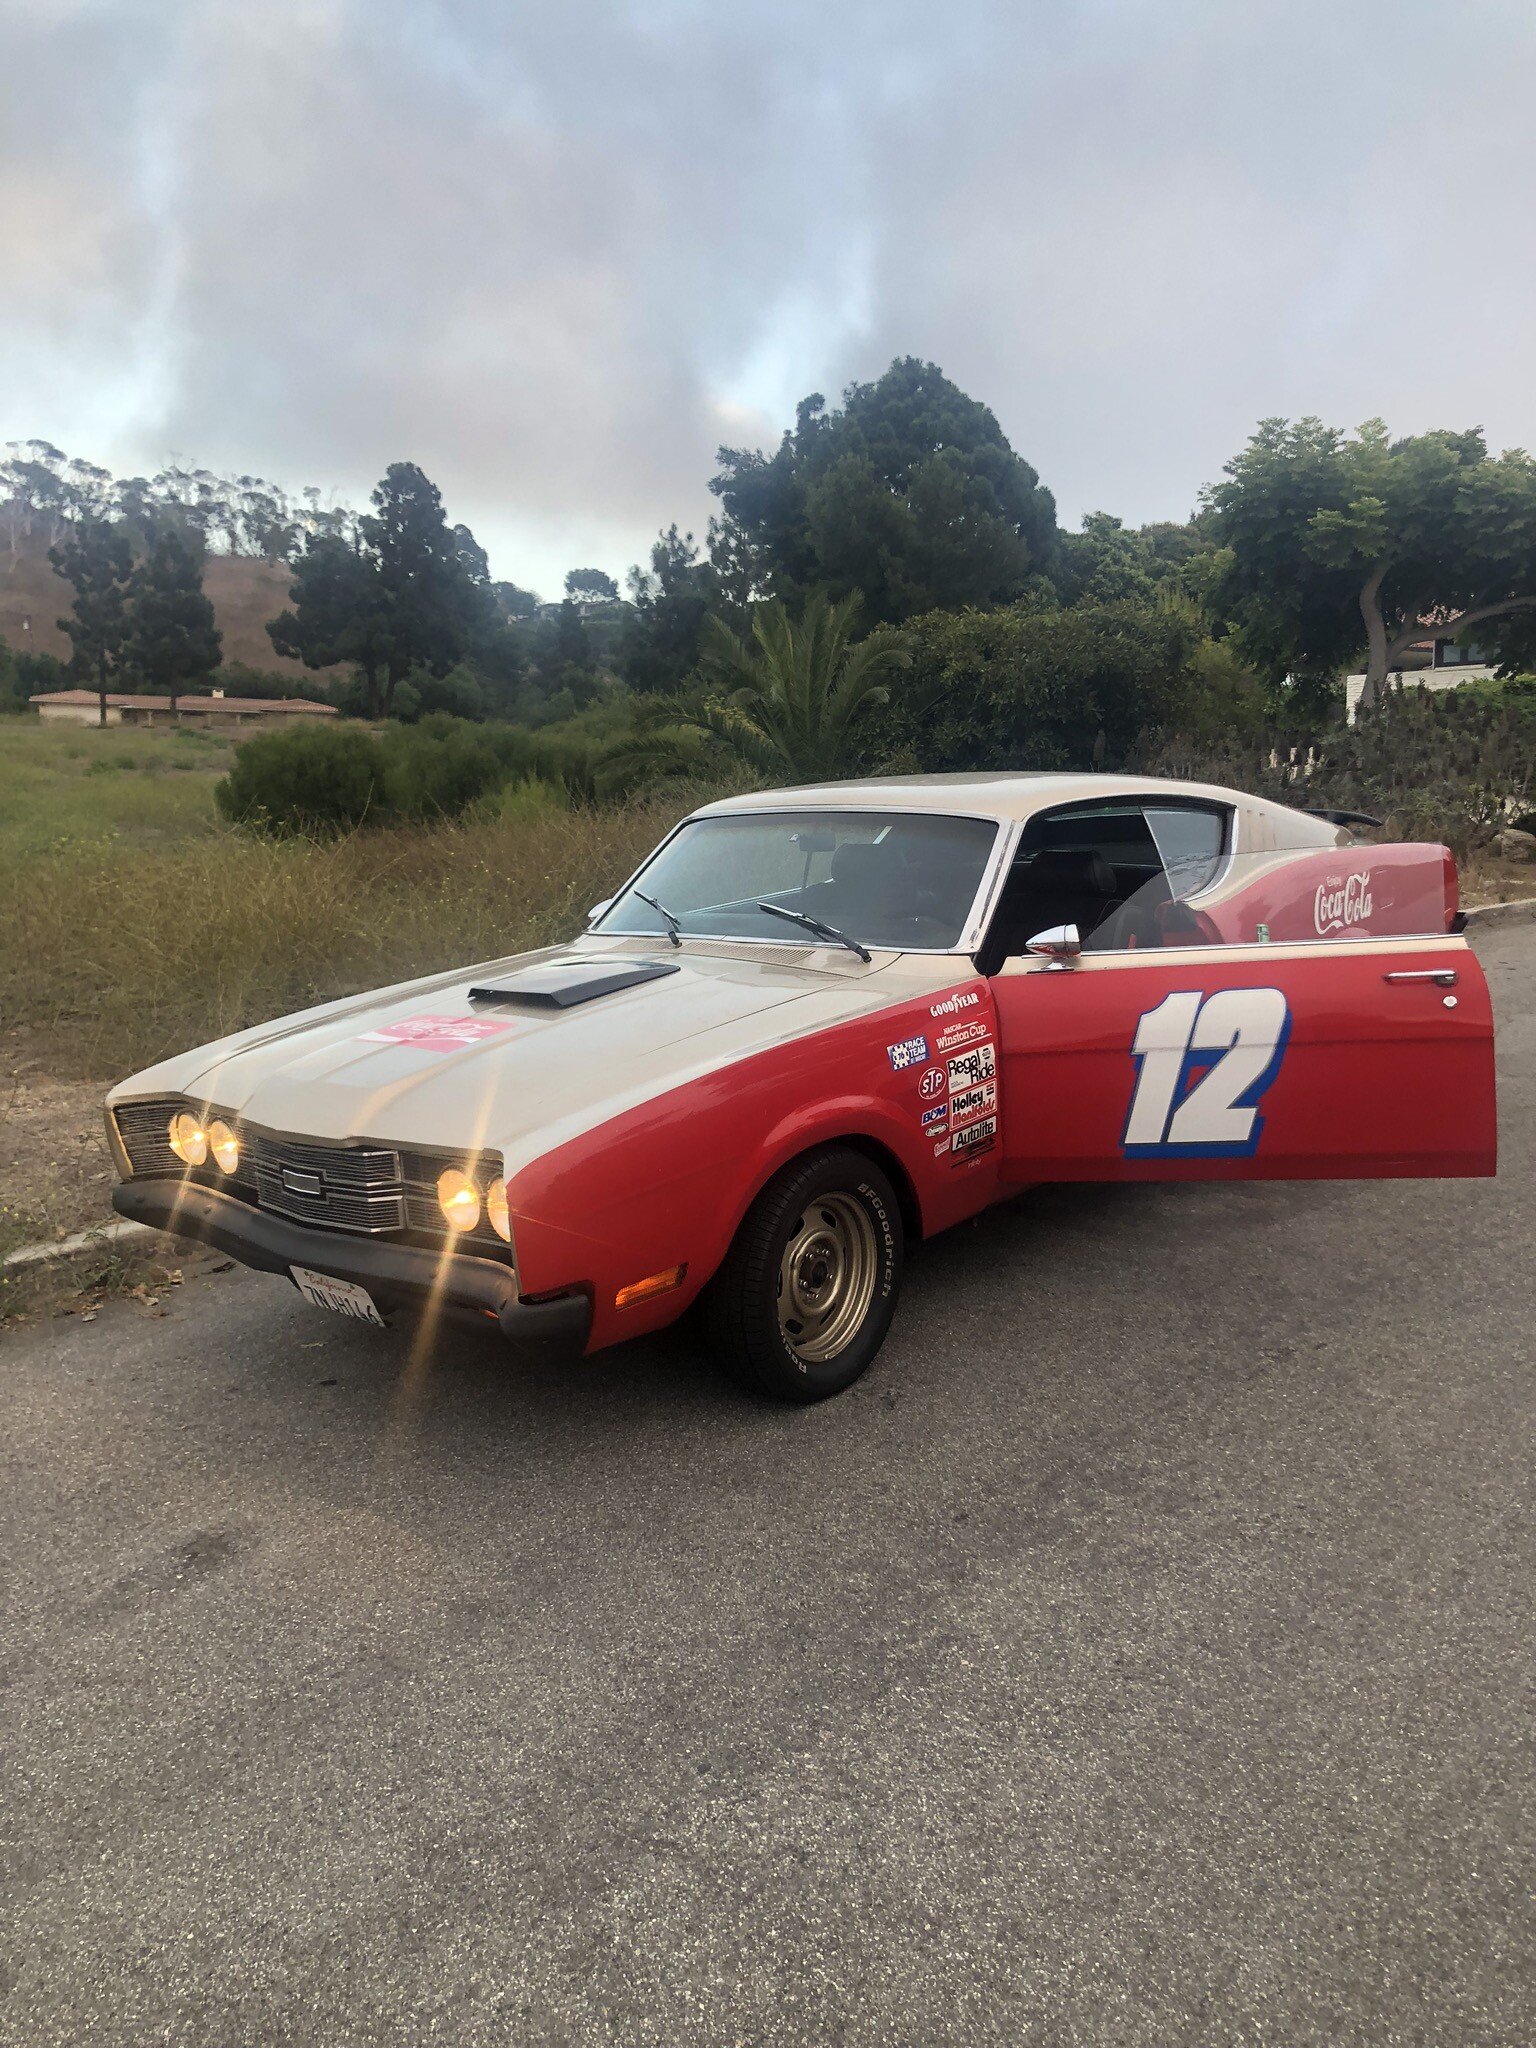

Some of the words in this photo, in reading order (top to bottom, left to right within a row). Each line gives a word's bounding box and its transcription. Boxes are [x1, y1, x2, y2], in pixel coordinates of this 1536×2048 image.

[930, 993, 980, 1018] GOODYEAR
[936, 1030, 970, 1049] Winston
[969, 1024, 987, 1037] Cup
[943, 1023, 963, 1036] NASCAR
[907, 1036, 926, 1050] RACE
[909, 1044, 927, 1058] TEAM
[947, 1050, 981, 1077] Regal
[970, 1062, 995, 1085] Ride
[1120, 986, 1290, 1152] 12
[922, 1070, 944, 1094] STP
[952, 1091, 984, 1114] Holley
[952, 1098, 996, 1126] Manifolds
[955, 1120, 994, 1149] Autolite
[857, 1183, 895, 1298] BFGoodrich
